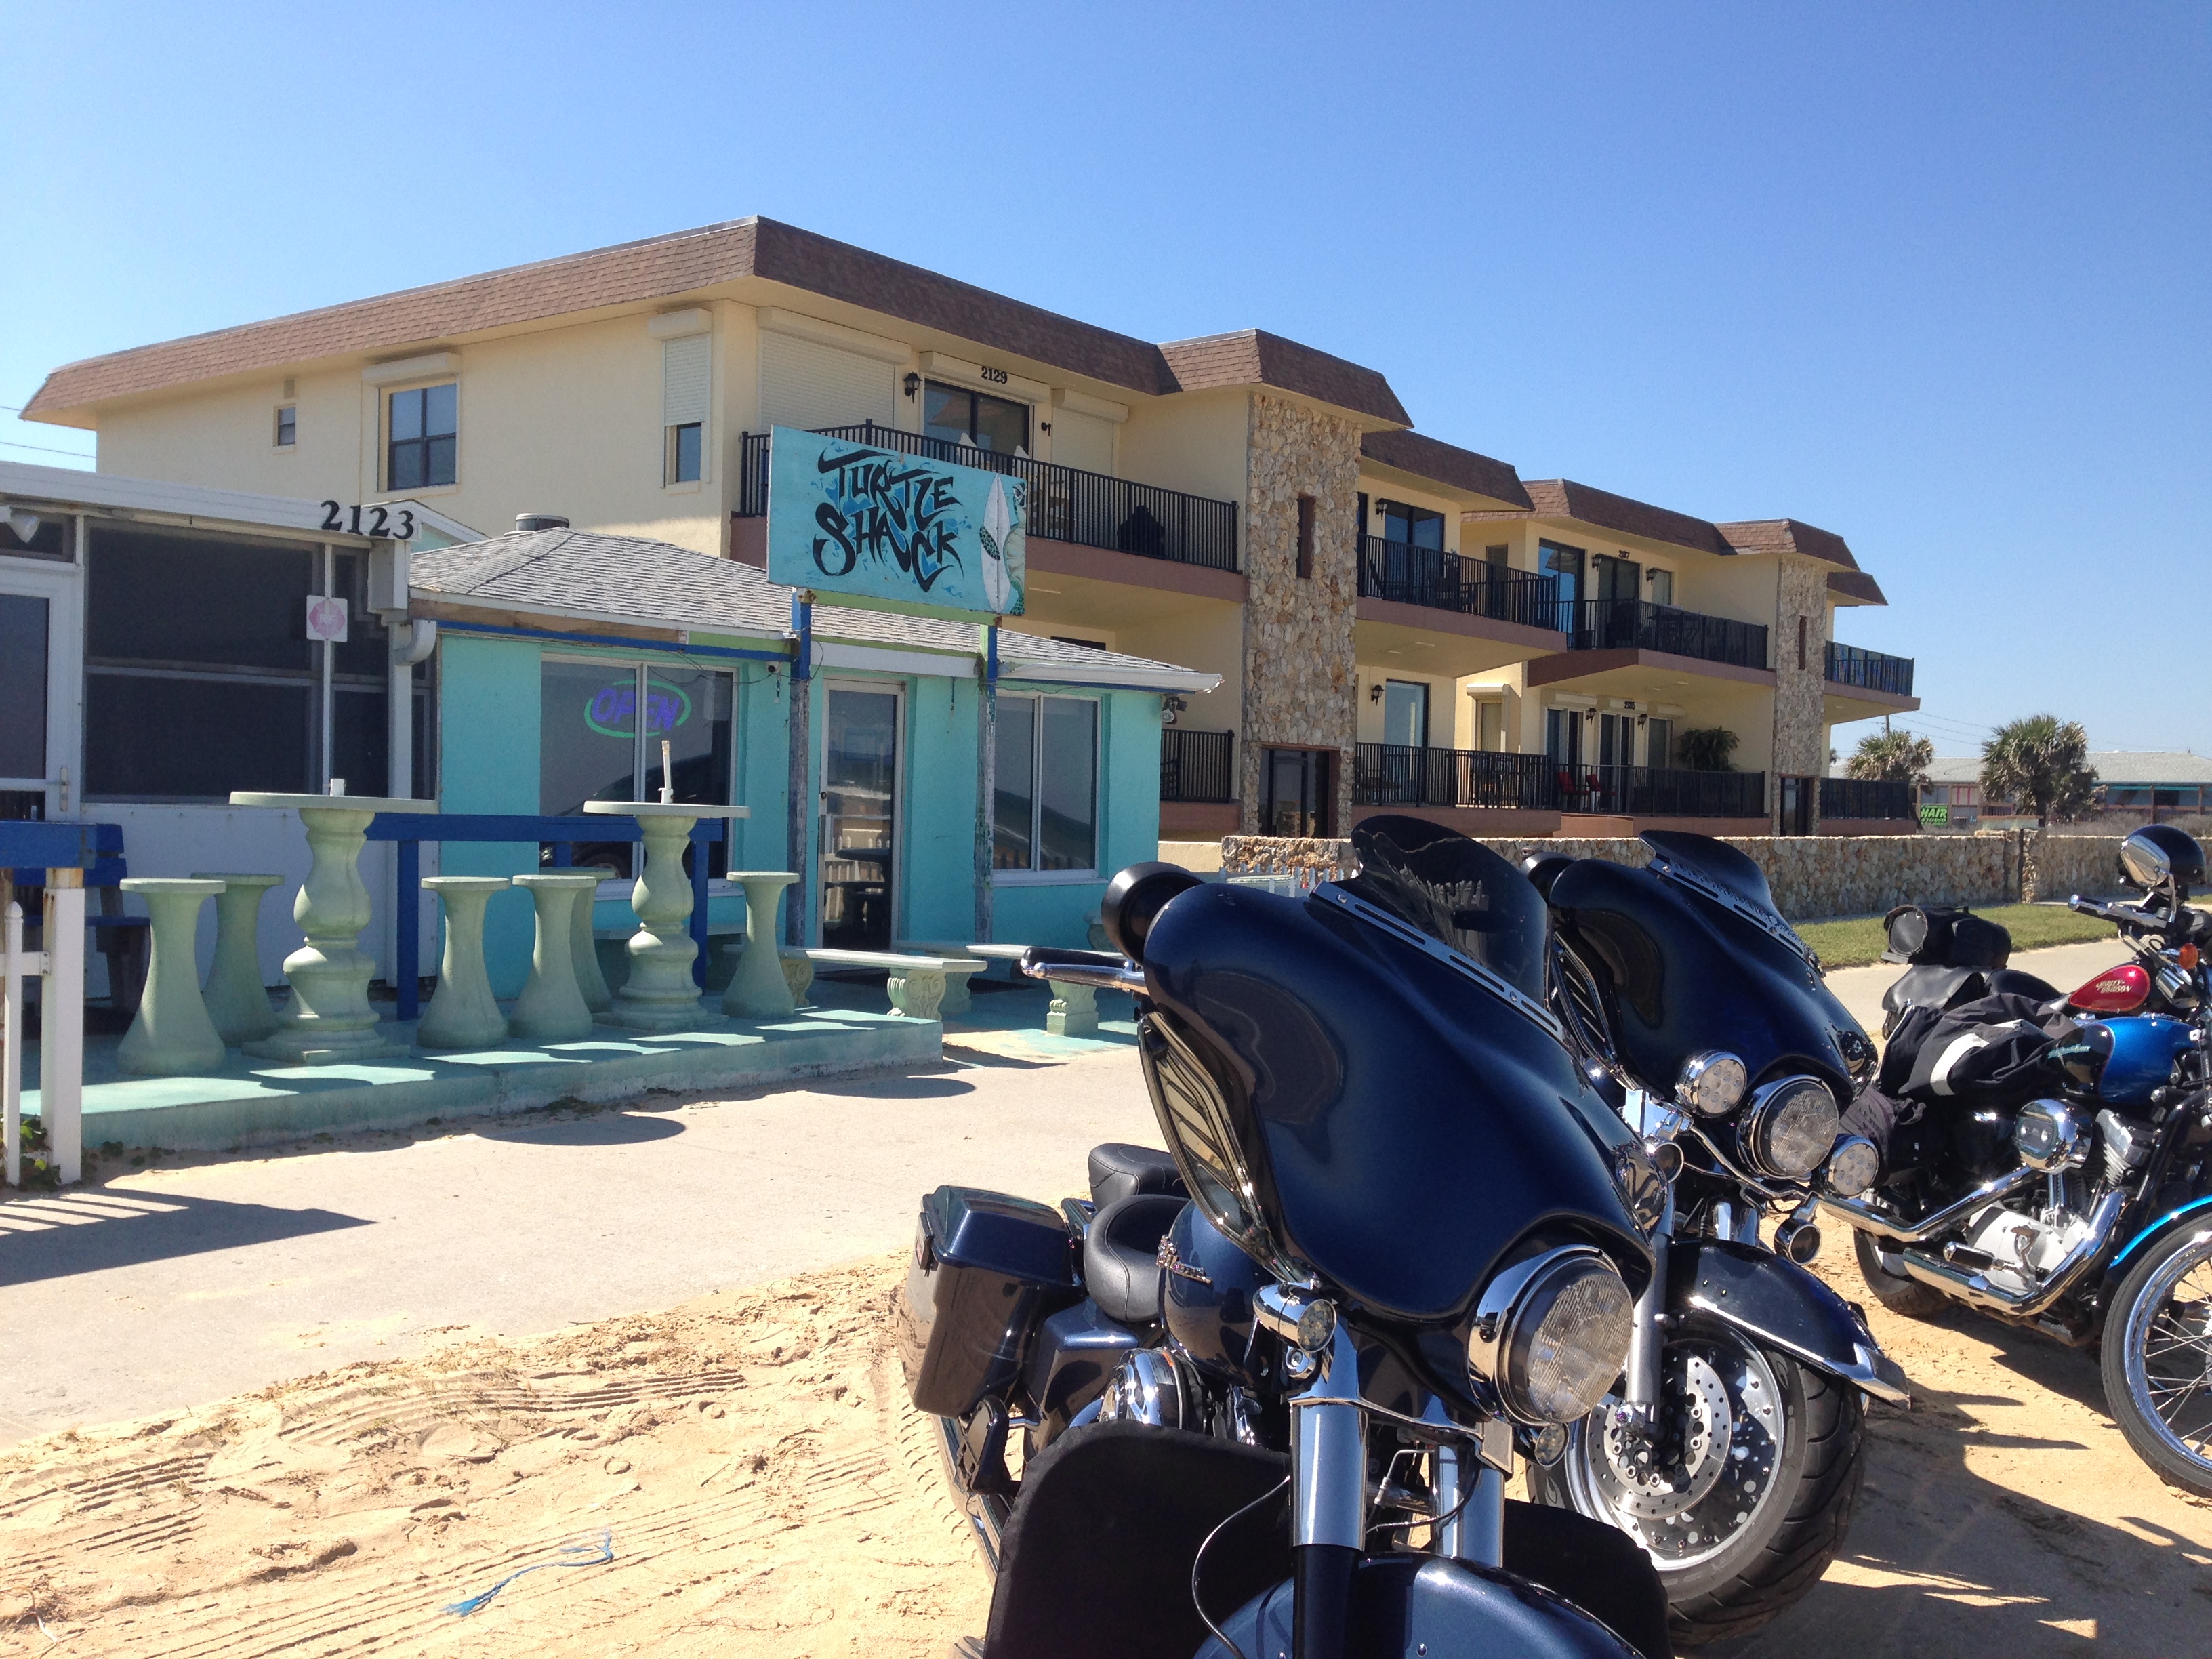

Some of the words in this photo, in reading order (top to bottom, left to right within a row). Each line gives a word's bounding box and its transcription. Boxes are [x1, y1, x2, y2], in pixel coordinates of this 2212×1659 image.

[981, 366, 1008, 384] 2129
[817, 447, 964, 531] TURTLE
[321, 500, 413, 539] 2123
[813, 500, 964, 592] SHACK
[592, 687, 680, 731] OPEN
[1921, 808, 1948, 818] HAIR
